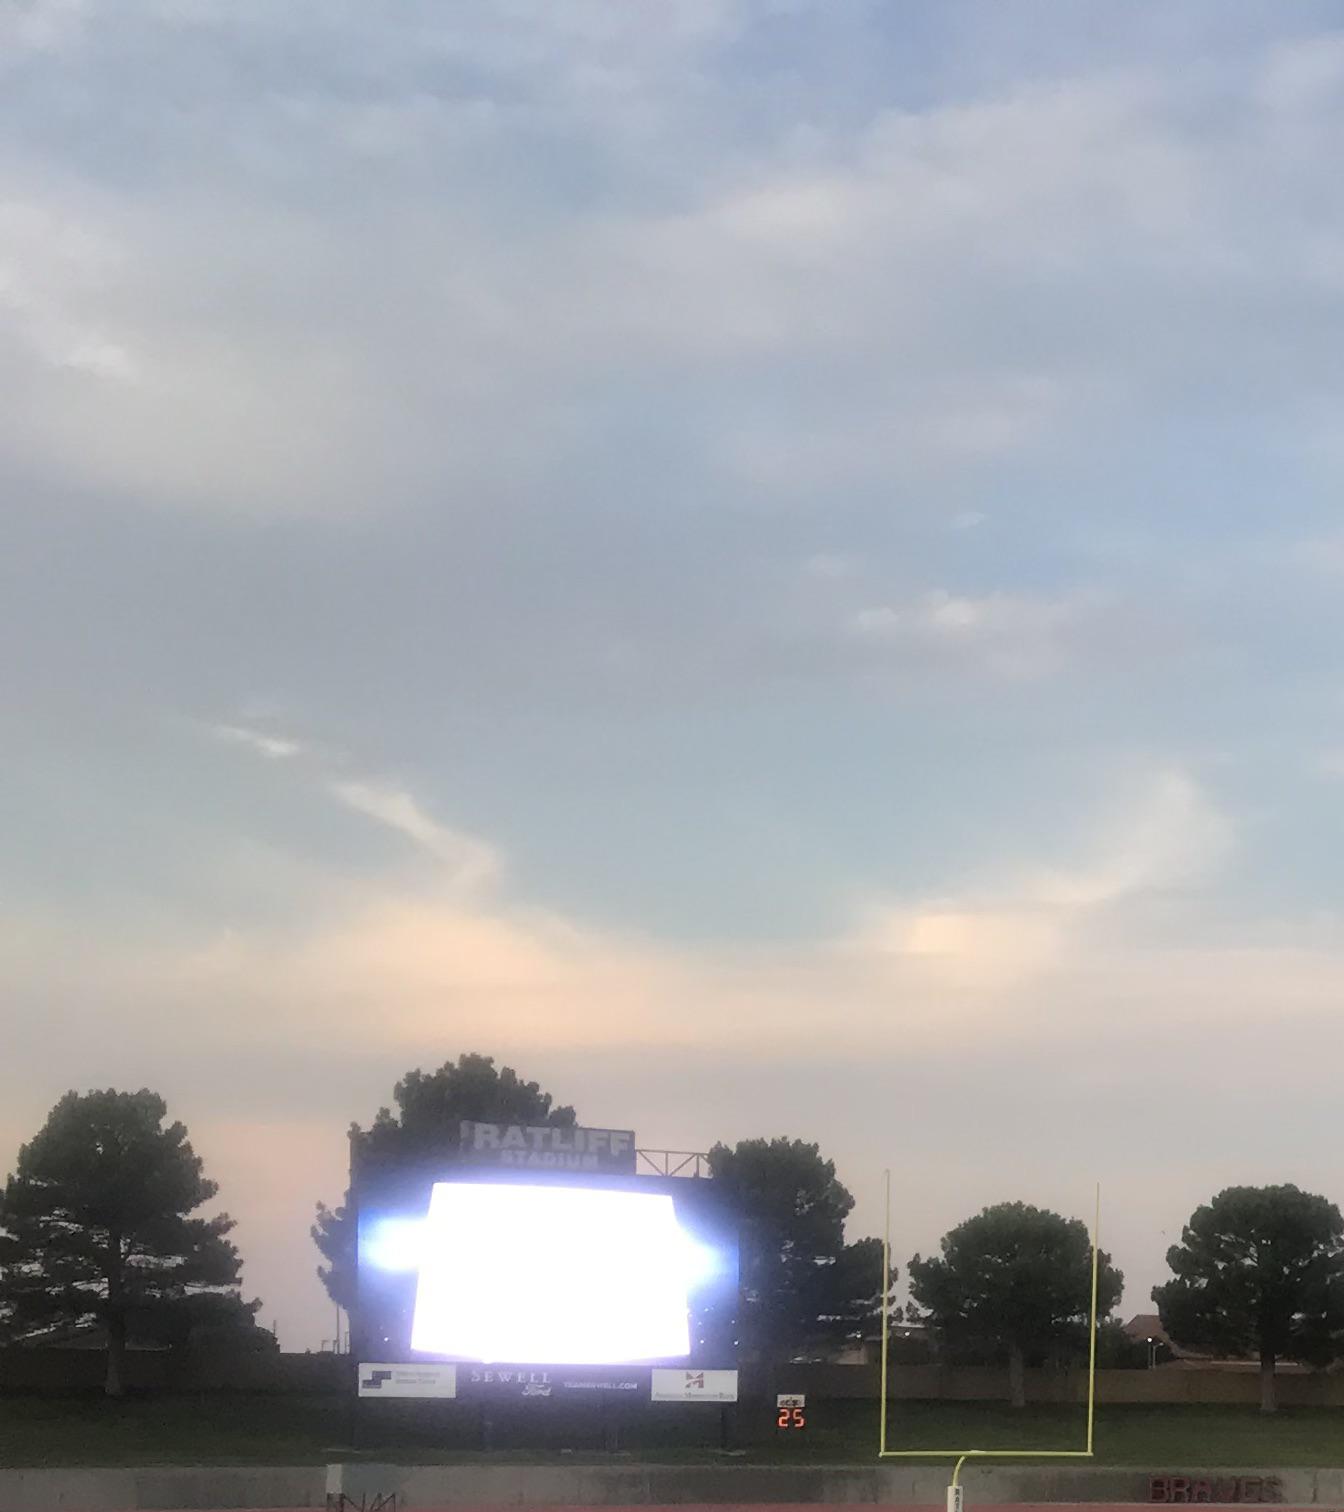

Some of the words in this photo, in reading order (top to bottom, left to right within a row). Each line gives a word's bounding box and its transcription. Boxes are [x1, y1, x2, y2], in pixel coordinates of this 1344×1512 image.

[474, 1122, 632, 1157] RATLIFF
[502, 1150, 598, 1170] STADIUM
[470, 1370, 552, 1383] SEWELL
[778, 1409, 805, 1427] 25
